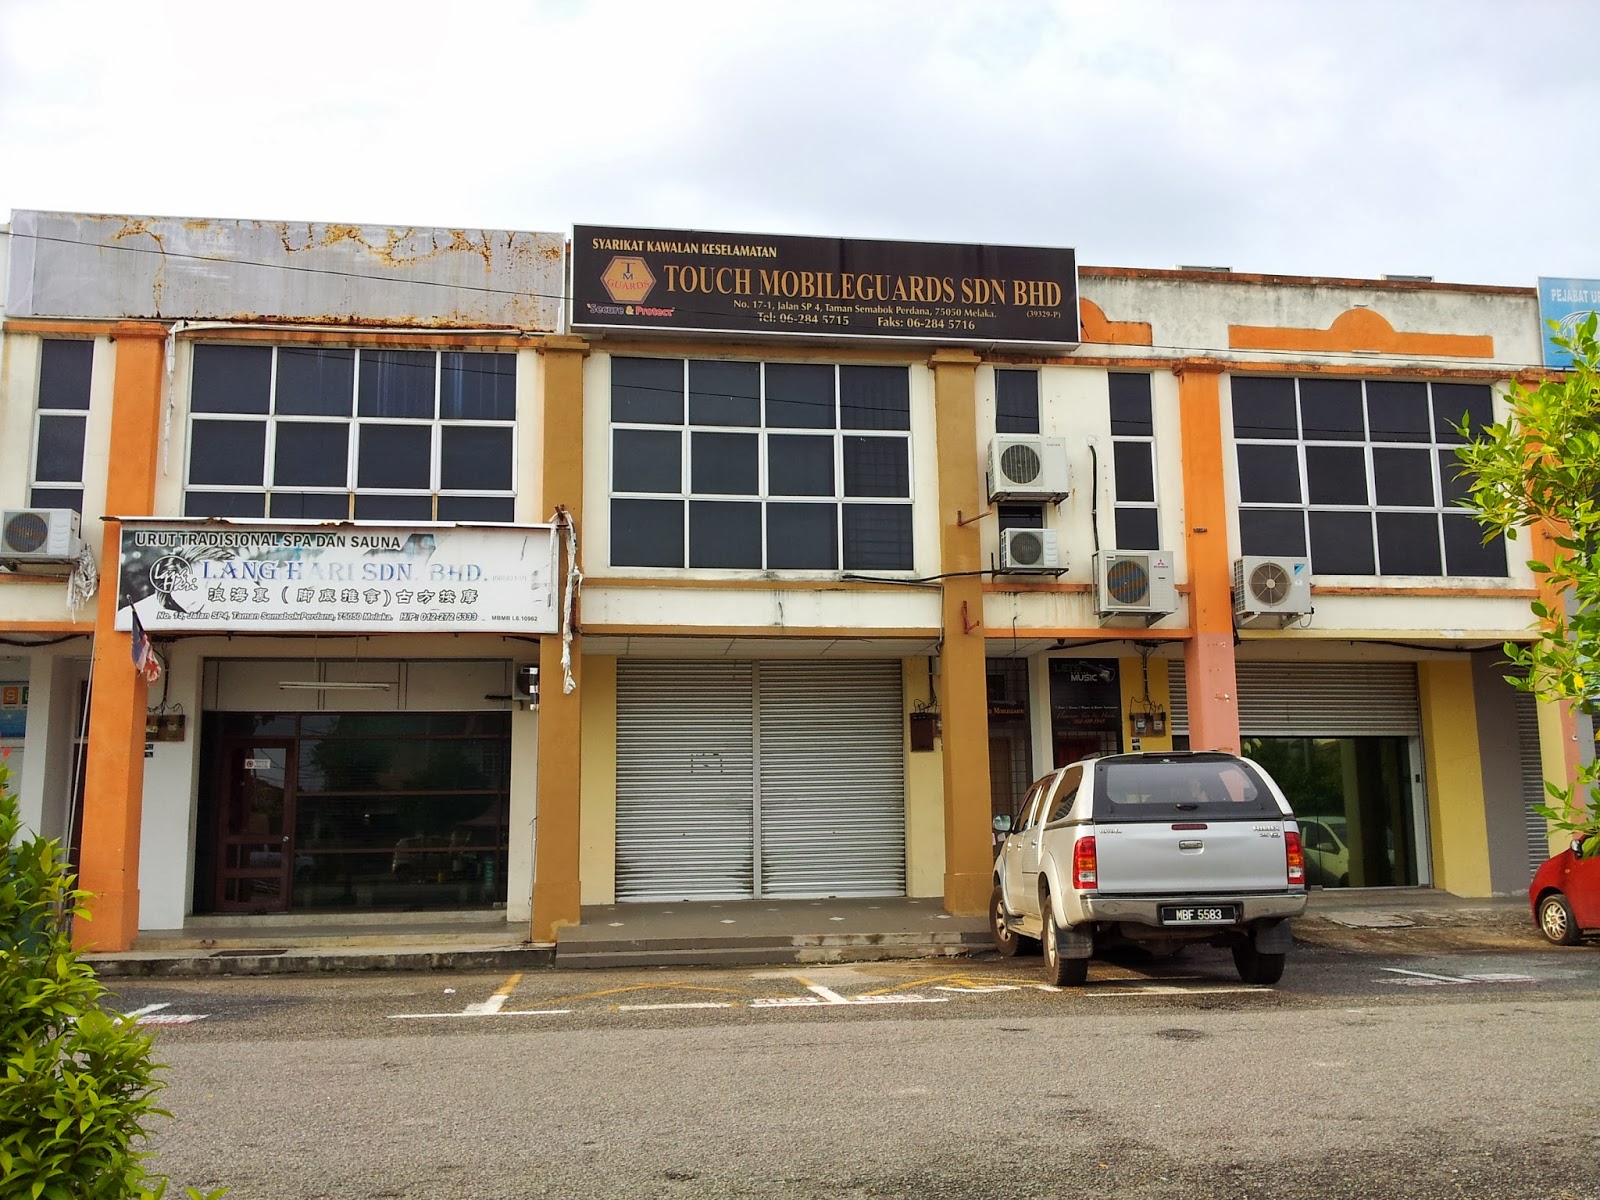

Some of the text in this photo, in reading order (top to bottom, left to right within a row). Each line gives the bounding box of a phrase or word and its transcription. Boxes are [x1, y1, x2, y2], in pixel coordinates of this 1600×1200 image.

[592, 238, 777, 258] SYARIKAT KAWALAN KESELAMATAN
[607, 278, 651, 290] GUARDS
[663, 265, 1062, 307] TOUCH MOBILEGUARDS SDN BHD
[1551, 288, 1588, 303] PEJABAT
[625, 305, 634, 315] &
[733, 299, 750, 309] No.
[753, 301, 775, 311] 17-1,
[777, 300, 799, 311] Jalan
[801, 302, 813, 311] SP
[824, 303, 853, 313] Taman
[855, 304, 894, 314] Semabok
[896, 306, 933, 317] Perdana,
[935, 307, 962, 316] 75050
[964, 308, 997, 318] Melaka.
[1027, 310, 1061, 319] (39329-P)
[757, 312, 850, 326] Tel: 06-284 5715
[877, 316, 975, 330] Faks: 06-284 5716
[135, 532, 401, 549] URUT TRADISIONAL SPA DAN SAUNA
[202, 560, 276, 580] LANG
[287, 561, 354, 581] HARI
[430, 563, 488, 582] BHD.
[156, 612, 171, 620] No.
[187, 612, 210, 620] Jalan
[211, 612, 230, 621] SP4,
[232, 612, 259, 620] Taman
[260, 612, 300, 620] Semabok
[301, 612, 336, 621] Perdana,
[337, 612, 362, 621] 75050
[362, 612, 393, 621] Melaka.
[420, 612, 455, 621] 012-272
[456, 612, 478, 621] 5333
[1070, 674, 1098, 682] MUSIC
[1176, 908, 1222, 920] MBF 5583
